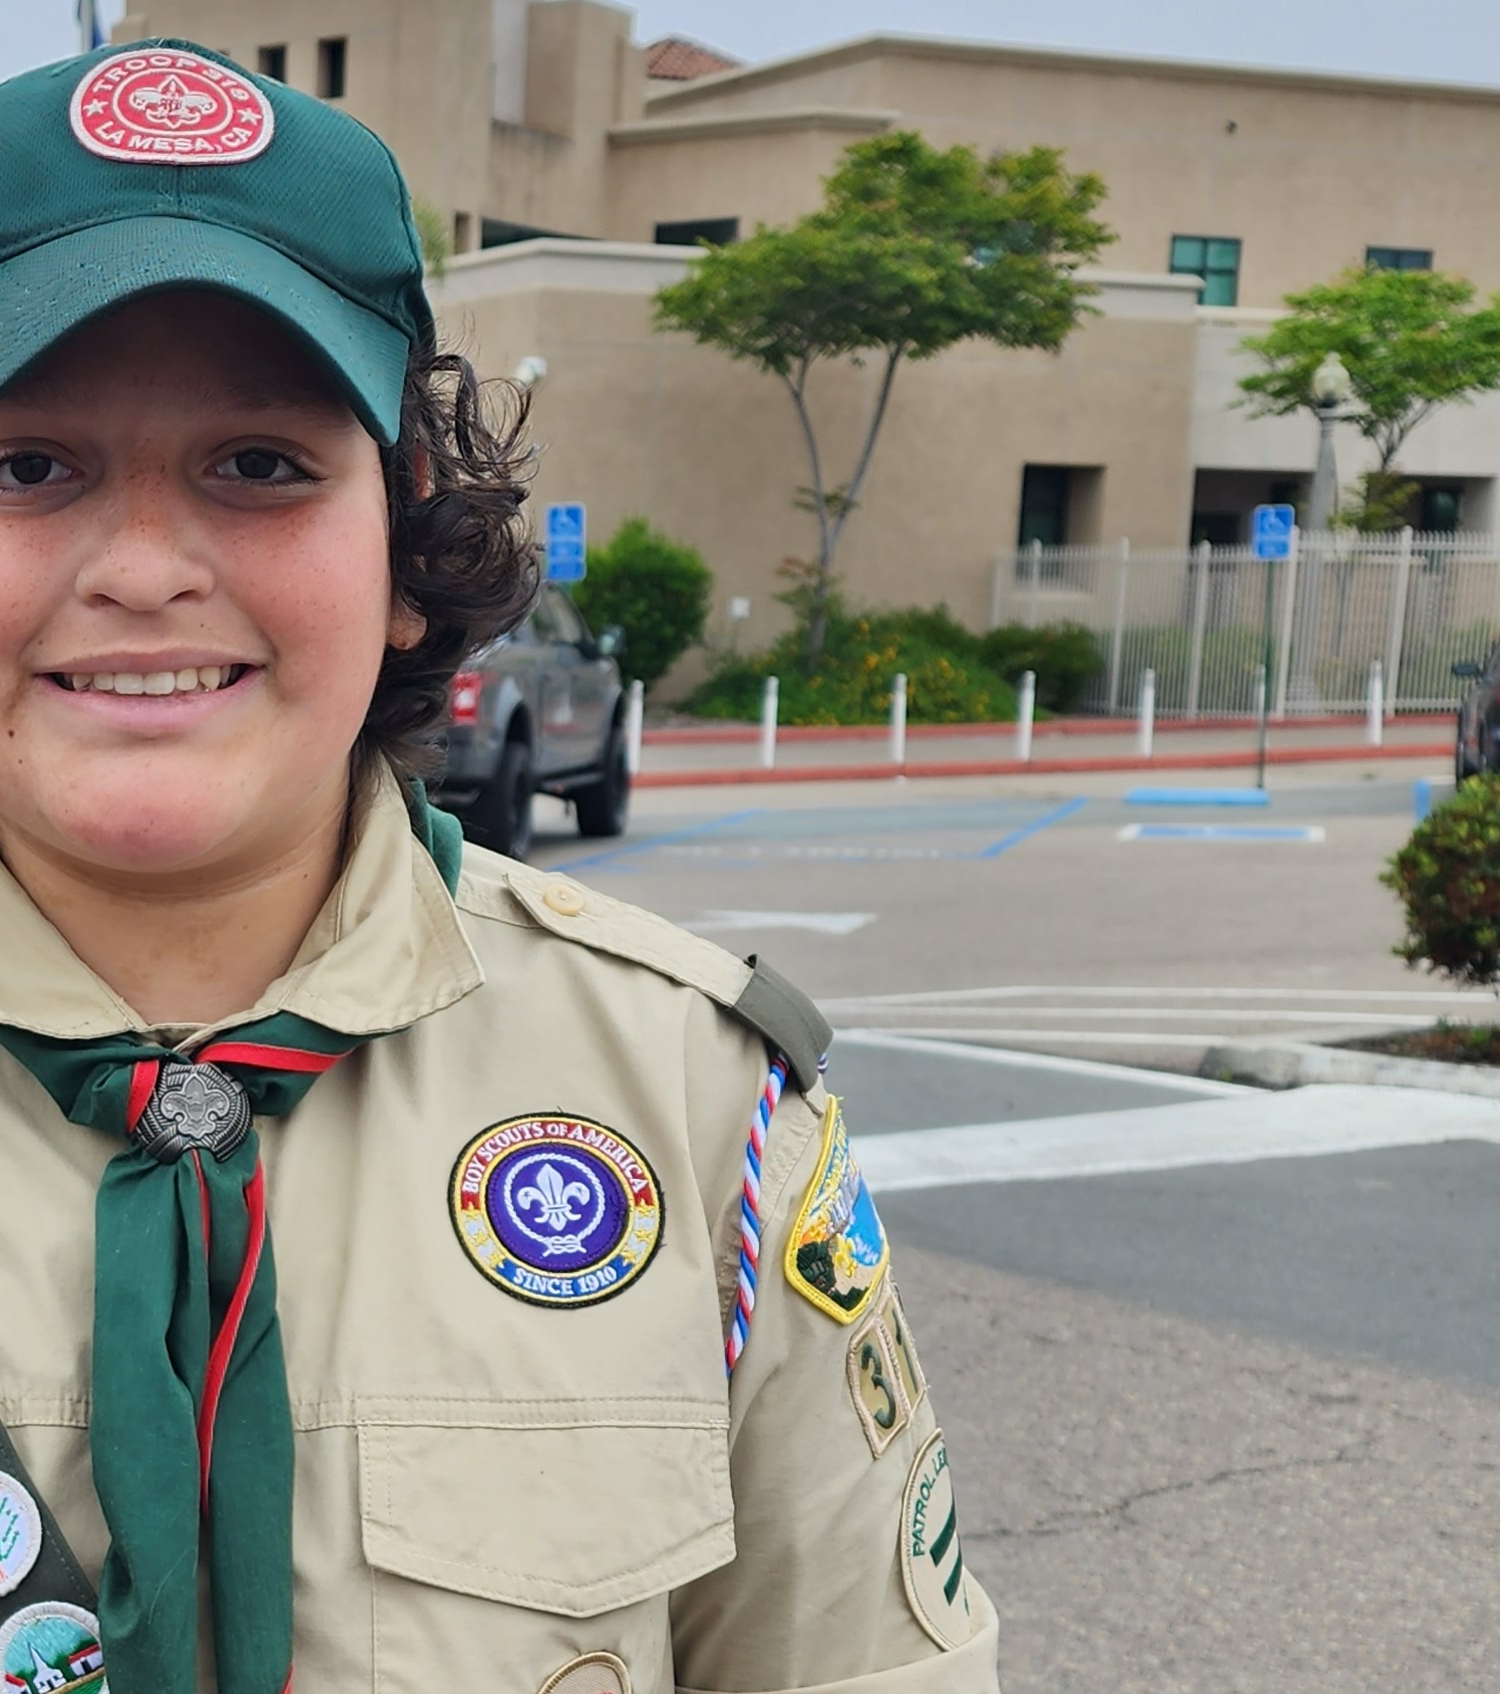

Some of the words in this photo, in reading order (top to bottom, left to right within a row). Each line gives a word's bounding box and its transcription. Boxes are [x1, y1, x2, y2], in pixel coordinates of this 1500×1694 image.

[92, 56, 198, 94] TROOP
[94, 120, 127, 145] LA
[128, 137, 224, 153] MESA,
[222, 126, 254, 148] CA
[461, 1155, 488, 1194] BOY
[478, 1121, 545, 1161] SCOUTS
[546, 1122, 569, 1137] OF
[567, 1123, 649, 1193] AMERICA
[512, 1266, 575, 1296] SINCE
[576, 1264, 619, 1293] 1910
[912, 1473, 937, 1557] PATROL
